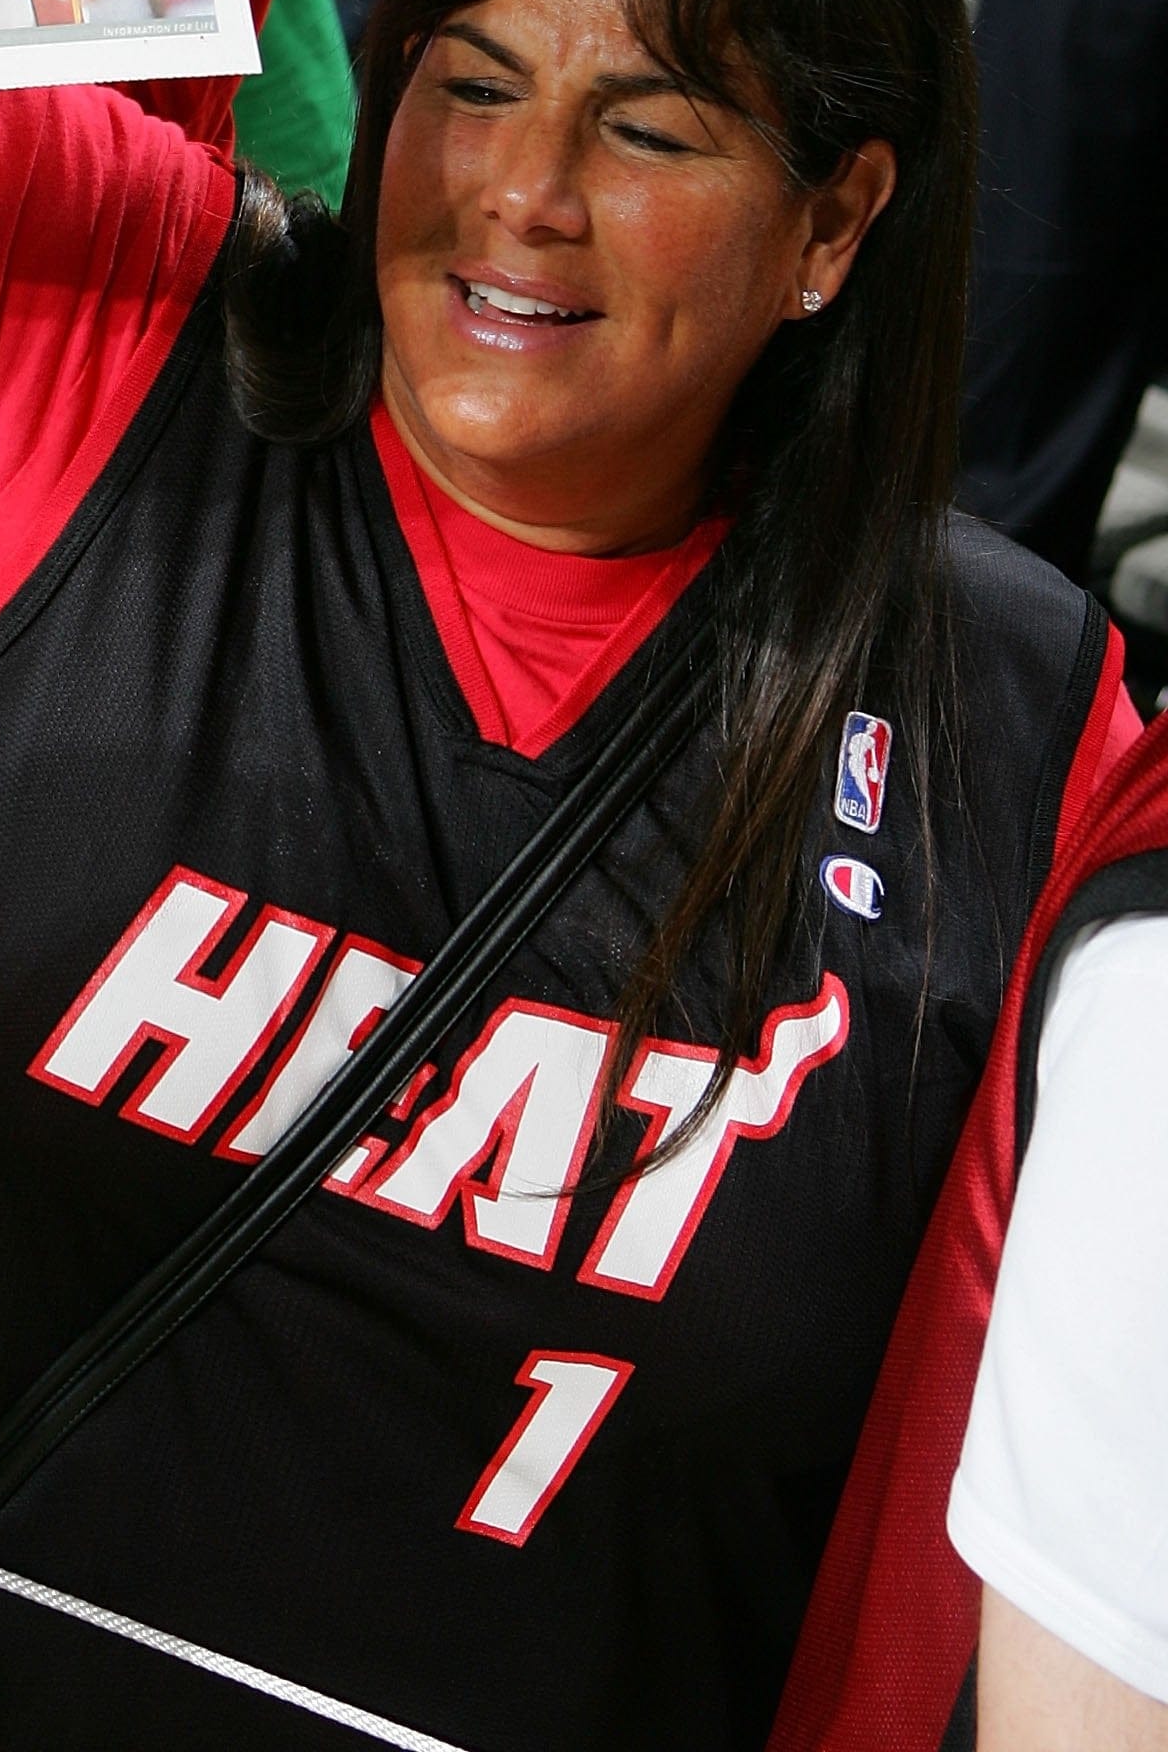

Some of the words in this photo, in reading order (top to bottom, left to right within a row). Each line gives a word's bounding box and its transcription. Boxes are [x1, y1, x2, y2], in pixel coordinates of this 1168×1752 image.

[103, 25, 171, 36] INFORMATION
[841, 797, 866, 821] NBA
[453, 1348, 636, 1548] 1
